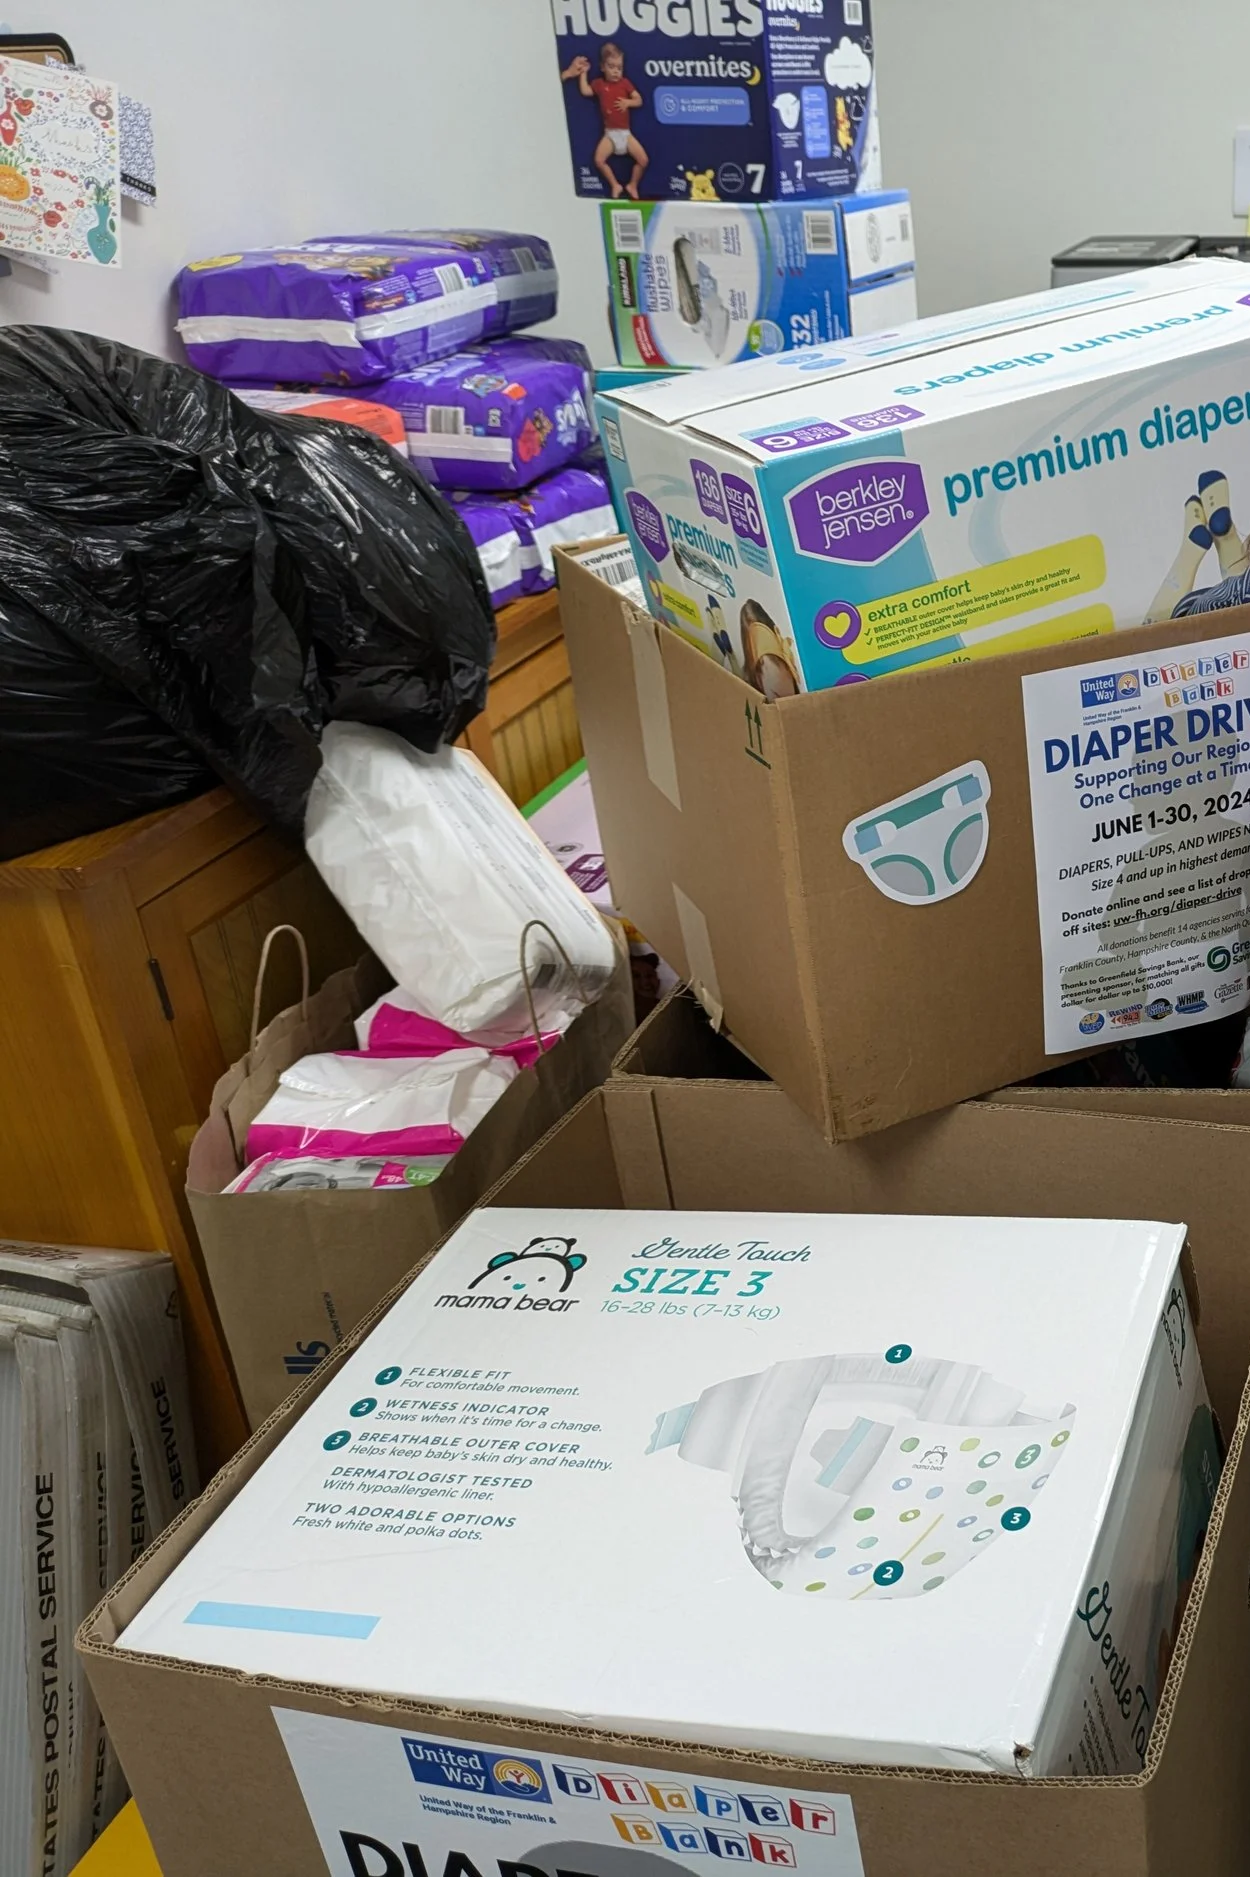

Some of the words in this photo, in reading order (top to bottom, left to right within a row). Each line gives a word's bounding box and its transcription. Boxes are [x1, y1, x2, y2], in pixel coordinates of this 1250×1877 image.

[552, 0, 764, 37] HUGGIES
[645, 54, 751, 78] overnites
[746, 164, 765, 194] 7
[655, 255, 669, 312] wipes
[1061, 304, 1232, 352] premium
[894, 350, 1055, 396] diapers
[943, 427, 1128, 516] premium
[816, 473, 906, 516] berkley
[666, 513, 738, 569] premium
[820, 501, 909, 549] jensen
[868, 600, 908, 623] extra
[912, 579, 972, 610] comfort
[873, 614, 918, 634] BREATHABLE
[918, 609, 936, 621] outer
[937, 602, 956, 617] cover
[956, 598, 974, 611] helps
[974, 592, 990, 606] keep
[1010, 580, 1025, 592] skin
[1025, 577, 1036, 590] dry
[1036, 573, 1048, 584] and
[1048, 567, 1071, 581] healthy
[1082, 677, 1114, 694] United
[1146, 653, 1249, 686] Diaper
[1095, 689, 1115, 702] Way
[1168, 680, 1233, 706] Bank
[1044, 715, 1179, 774] DIAPER
[1074, 756, 1167, 789] Supporting
[1171, 749, 1203, 767] Our
[1079, 792, 1114, 810] One
[1118, 776, 1182, 800] Change
[1186, 771, 1203, 786] at
[1206, 768, 1217, 781] a
[1091, 814, 1142, 843] JUNE
[1147, 803, 1198, 829] 1-30,
[1058, 857, 1113, 880] DIAPERS,
[1116, 843, 1175, 866] PULL-UPS,
[1177, 836, 1205, 852] AND
[1207, 826, 1242, 845] WIPES
[1091, 877, 1114, 892] Size
[1116, 874, 1124, 885] 4
[1126, 867, 1148, 883] and
[1150, 866, 1164, 878] up
[1166, 862, 1177, 874] in
[1179, 852, 1219, 871] highest
[1062, 905, 1104, 922] Donate
[1106, 896, 1141, 912] online
[1143, 888, 1165, 903] and
[1167, 885, 1186, 897] see
[1187, 884, 1195, 892] a
[1197, 879, 1214, 890] list
[1215, 872, 1228, 885] of
[1062, 924, 1080, 938] off
[1082, 919, 1111, 934] sites:
[1113, 886, 1242, 928] uw-fh.org/diaper-drive
[631, 1237, 730, 1261] Gentle
[736, 1240, 812, 1262] Touch
[611, 1267, 730, 1296] SIZE
[737, 1270, 774, 1297] 3
[434, 1293, 511, 1310] mama
[513, 1294, 579, 1313] bear
[657, 1301, 688, 1316] lbs
[746, 1305, 781, 1321] kg)
[400, 1378, 424, 1389] For
[425, 1379, 505, 1393] comfortable
[506, 1384, 580, 1396] movement.
[408, 1367, 481, 1379] FLEXIBLE
[483, 1370, 512, 1380] FIT
[386, 1399, 458, 1412] WETNESS
[462, 1403, 550, 1416] INDICATOR
[150, 1377, 185, 1501] SERVICE
[358, 1432, 462, 1447] BREATHABLE
[465, 1438, 520, 1451] OUTER
[524, 1441, 581, 1454] COVER
[331, 1466, 467, 1485] DERMATOLOGIST
[472, 1476, 533, 1489] TESTED
[304, 1502, 342, 1514] TWO
[345, 1504, 438, 1522] ADORABLE
[441, 1513, 517, 1528] OPTIONS
[35, 1472, 57, 1619] SERVICE
[41, 1624, 61, 1760] POSTAL
[407, 1743, 484, 1771] United
[441, 1765, 486, 1791] Way
[564, 1768, 833, 1832] Diaper
[622, 1818, 793, 1866] Bank
